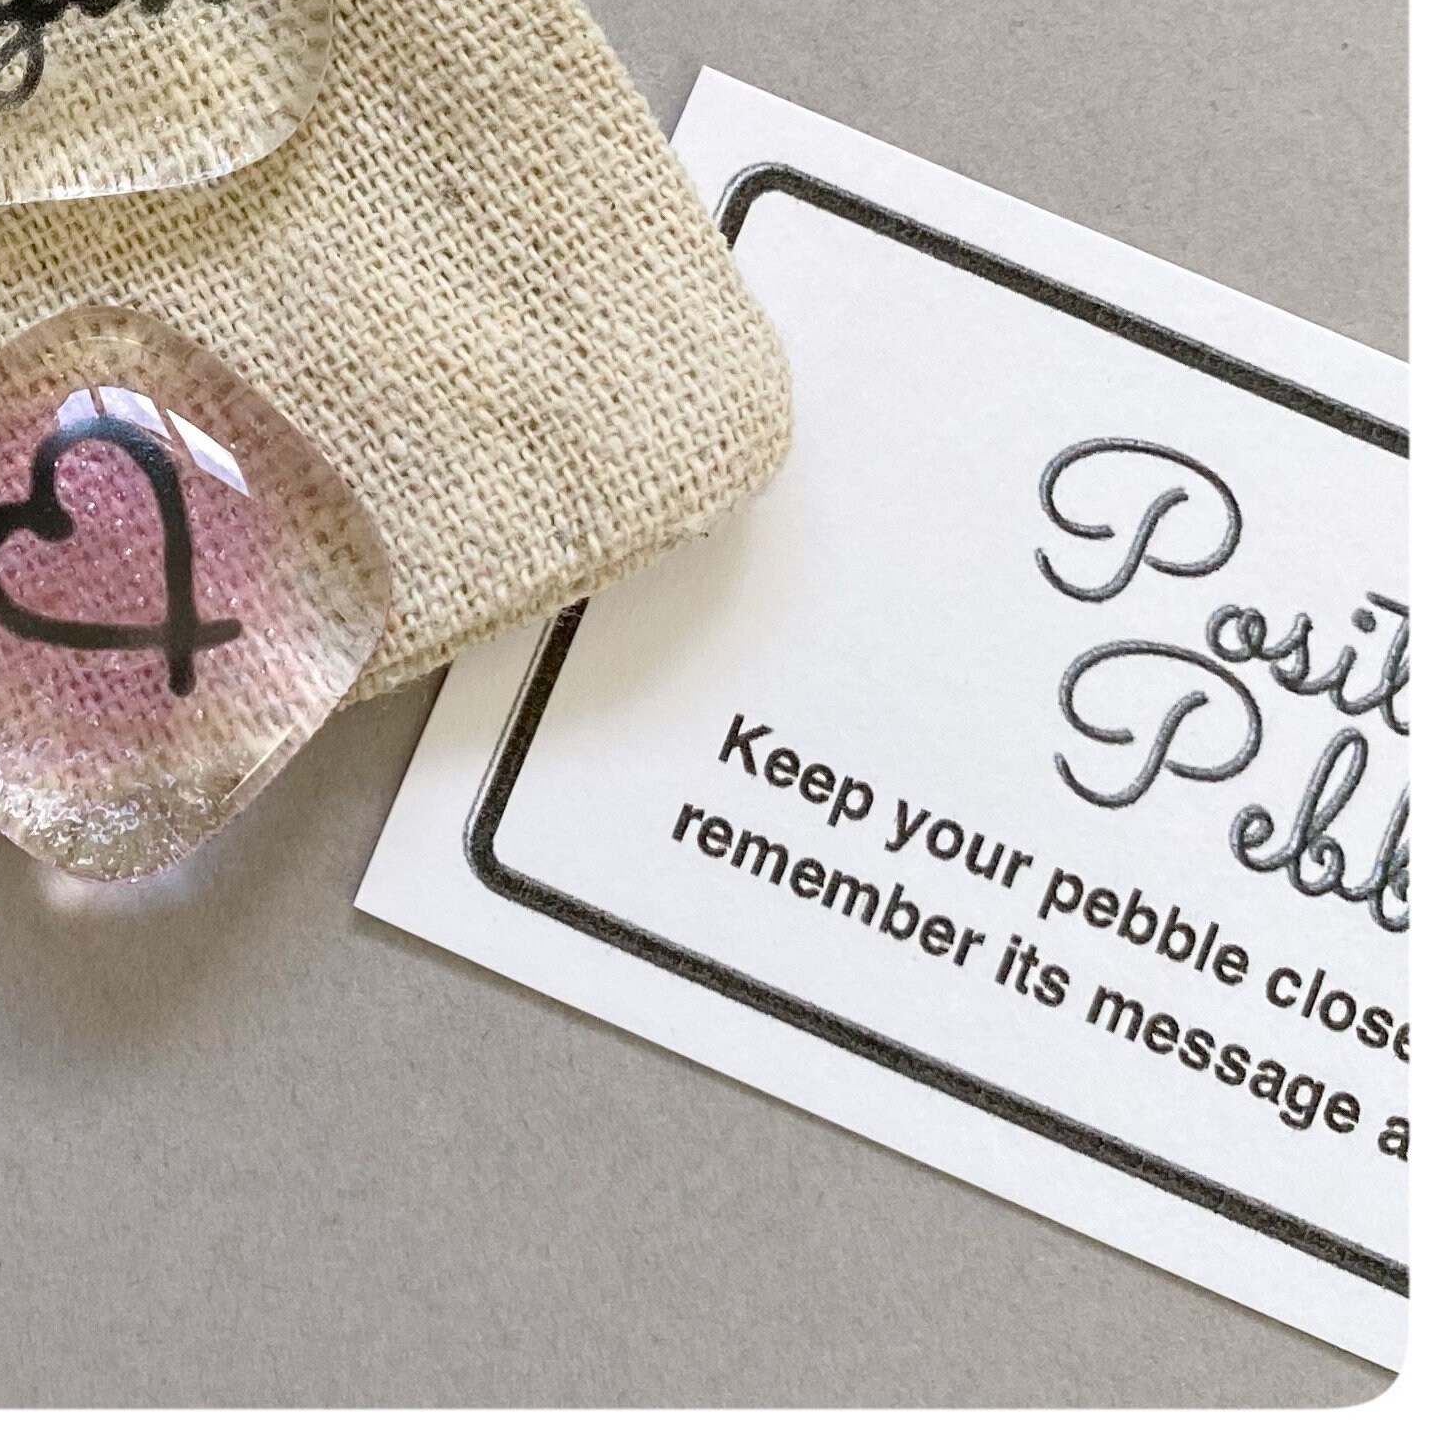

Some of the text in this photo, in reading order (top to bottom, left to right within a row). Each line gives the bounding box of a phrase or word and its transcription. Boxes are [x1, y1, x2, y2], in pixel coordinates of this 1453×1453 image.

[671, 803, 986, 967] remember
[994, 934, 1070, 1008] its
[1086, 984, 1360, 1134] message
[718, 713, 874, 827] Keep
[884, 798, 1034, 889] your
[1037, 867, 1250, 986] pebble
